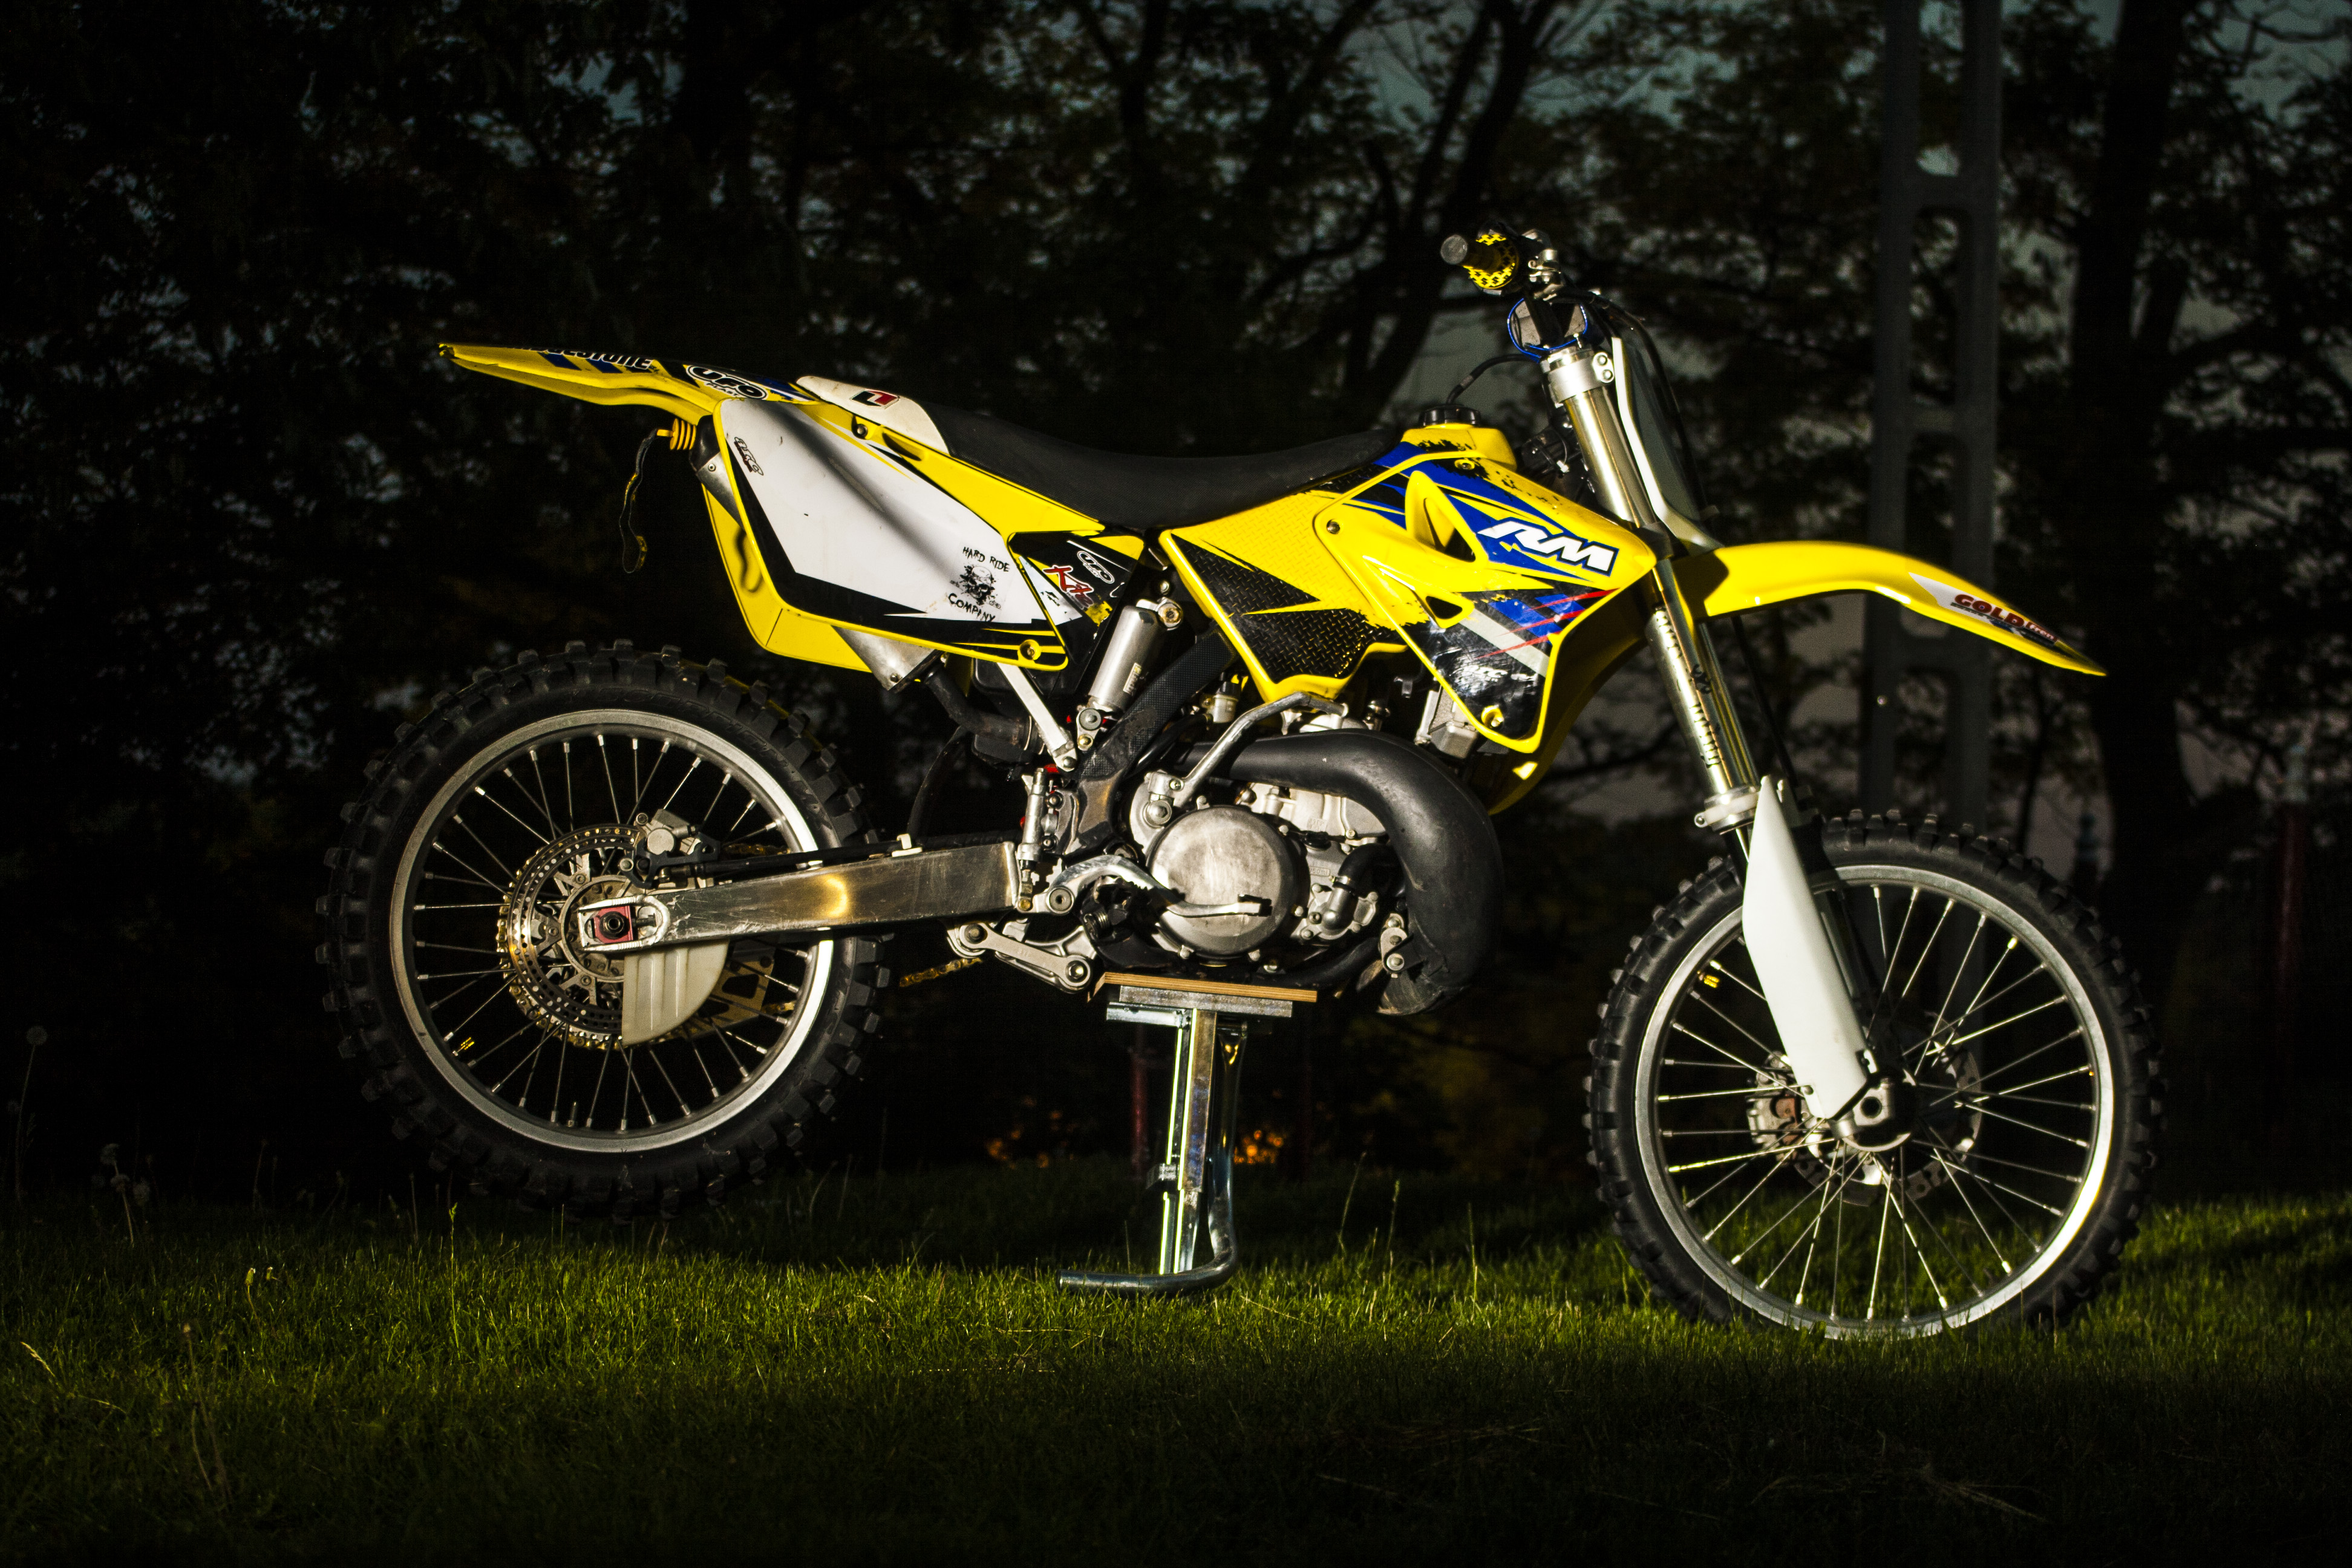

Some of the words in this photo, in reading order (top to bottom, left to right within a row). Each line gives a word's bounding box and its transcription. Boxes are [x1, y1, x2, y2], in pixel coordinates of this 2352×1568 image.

[691, 366, 764, 399] UFO
[962, 546, 985, 563] HARD
[990, 556, 1010, 572] RIDE
[1477, 520, 1615, 572] RM
[1079, 552, 1113, 583] UFO
